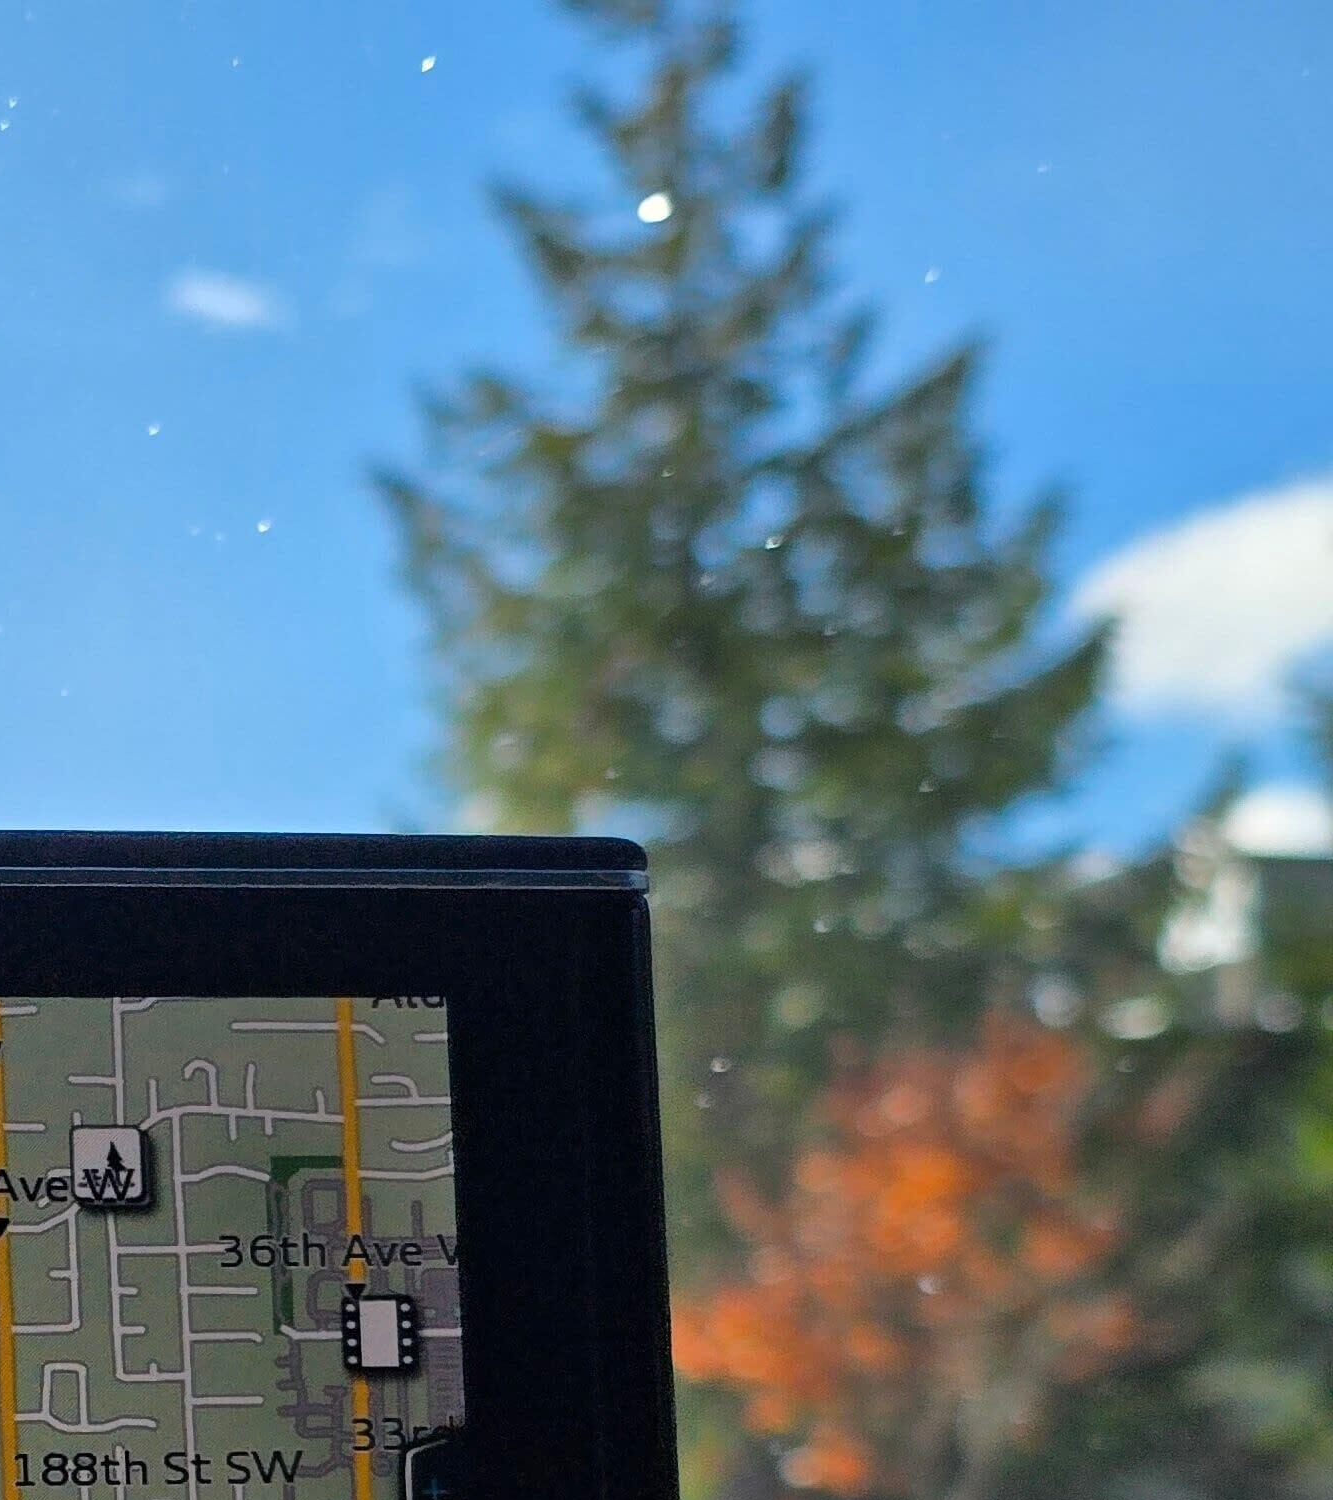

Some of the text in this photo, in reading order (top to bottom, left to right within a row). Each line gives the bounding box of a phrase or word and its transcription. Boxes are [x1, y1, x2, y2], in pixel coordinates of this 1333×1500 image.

[82, 1169, 134, 1200] W
[219, 1233, 326, 1268] 36th
[342, 1234, 422, 1267] Ave
[352, 1416, 454, 1450] 33r
[14, 1450, 303, 1488] 188th St SW
